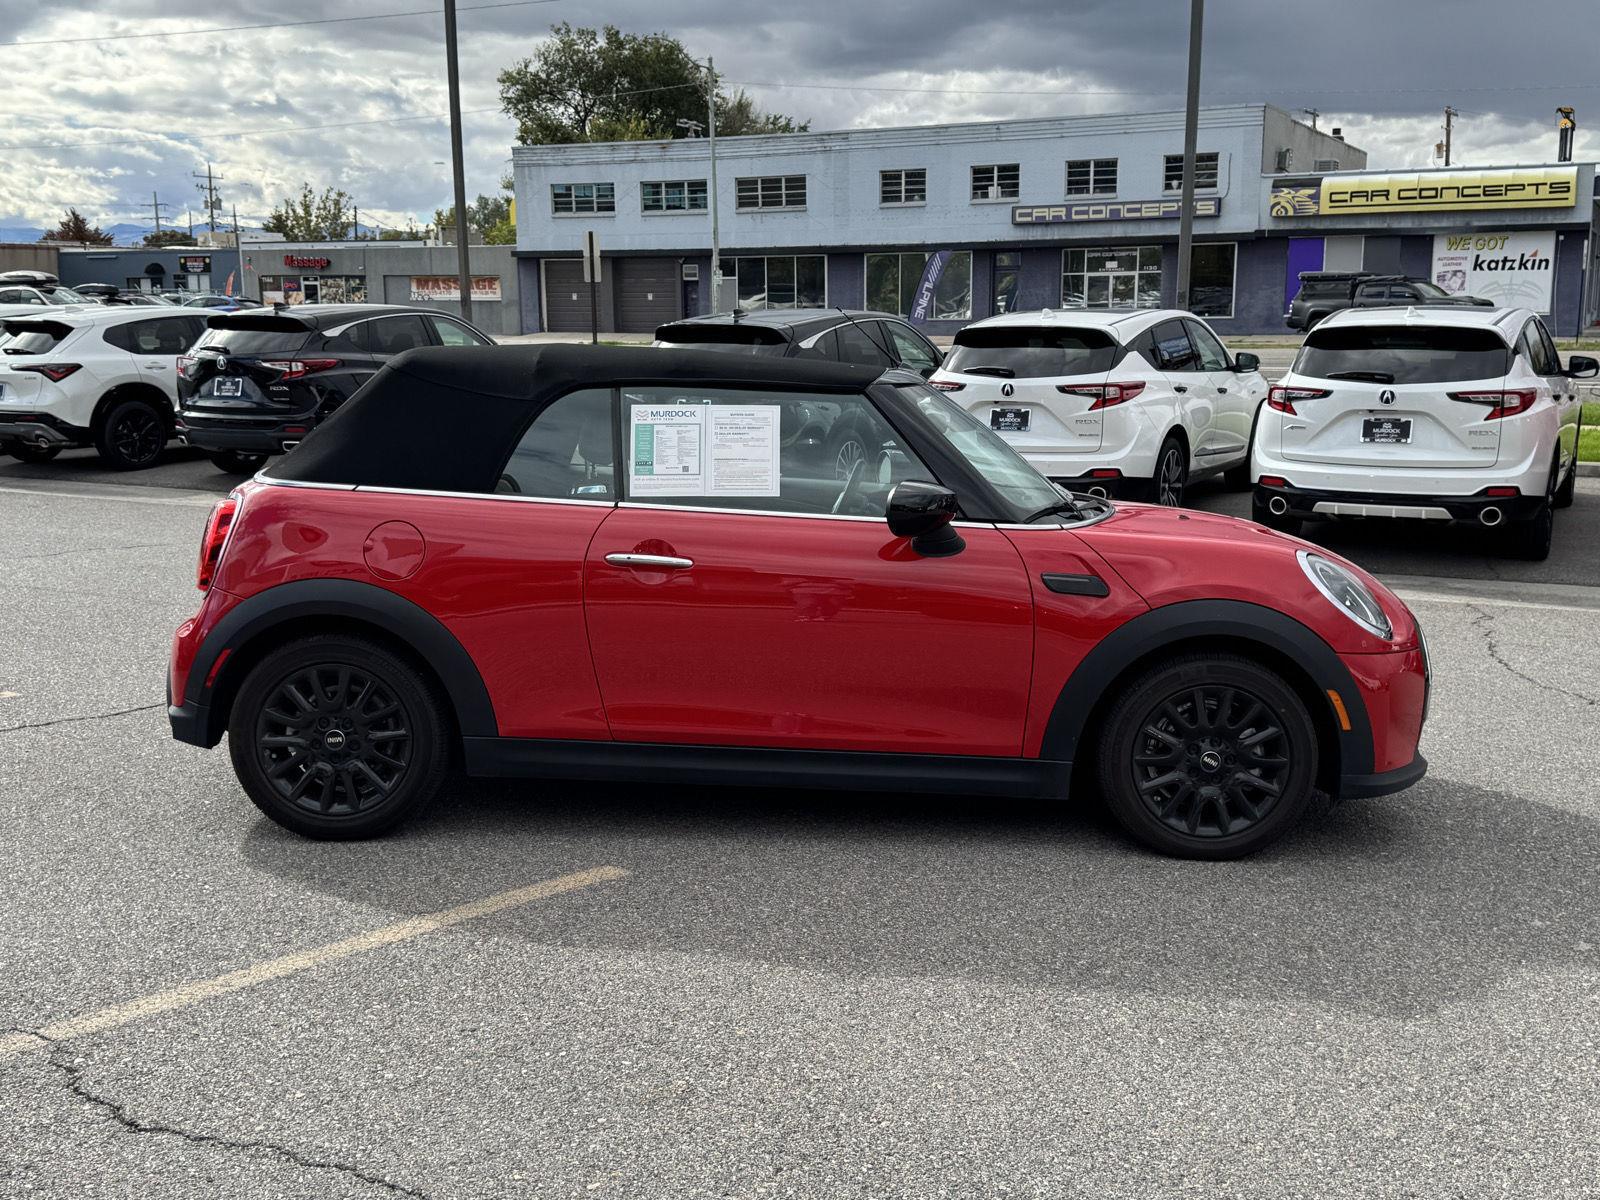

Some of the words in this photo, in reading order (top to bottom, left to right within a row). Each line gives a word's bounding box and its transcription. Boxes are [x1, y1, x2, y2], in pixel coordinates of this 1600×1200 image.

[1328, 188, 1391, 204] CAR
[1397, 180, 1571, 200] CONCEPTS
[1015, 207, 1067, 222] CAR
[1071, 200, 1216, 220] CONCEPS
[1446, 235, 1473, 251] WE
[1474, 235, 1509, 250] GOT
[283, 255, 328, 269] Massage
[1472, 250, 1550, 272] katzkin
[914, 265, 938, 320] ALPINE
[650, 410, 697, 418] MURDOCK
